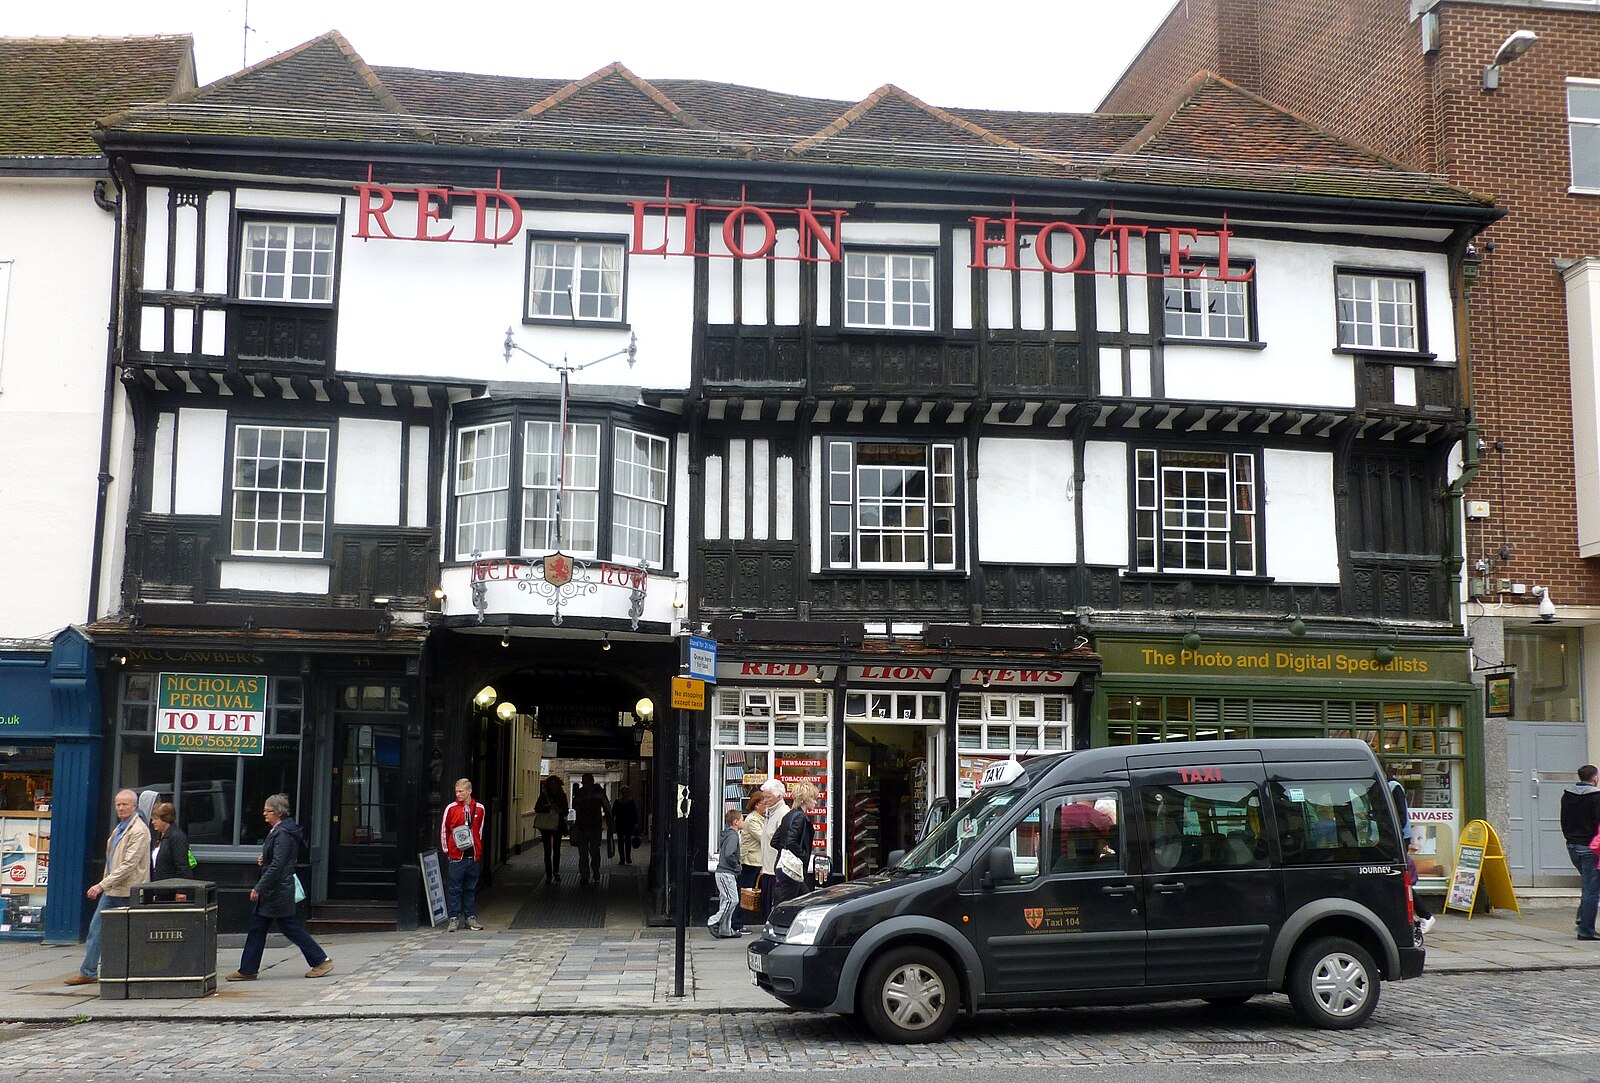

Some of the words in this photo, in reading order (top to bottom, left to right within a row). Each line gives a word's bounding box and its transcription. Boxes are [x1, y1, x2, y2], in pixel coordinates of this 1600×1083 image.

[352, 185, 523, 245] RED
[628, 200, 849, 263] LION
[968, 216, 1255, 282] HOTEL
[1142, 649, 1176, 665] The
[1180, 650, 1233, 666] Photo
[1237, 652, 1270, 668] and
[1276, 653, 1331, 673] Digital
[740, 661, 809, 677] RED
[860, 665, 937, 680] LION
[971, 668, 1063, 682] NEWS
[167, 676, 258, 694] NICHOLAS
[169, 693, 254, 709] PERCIVAL
[682, 690, 703, 699] stopping
[164, 712, 199, 730] TO
[207, 713, 256, 732] LET
[161, 734, 204, 746] 01206
[207, 735, 258, 748] 563222
[984, 766, 1005, 782] TAXI
[1178, 767, 1222, 783] TAXI
[1408, 811, 1454, 821] NVASES
[11, 868, 26, 876] £22
[1359, 866, 1391, 875] JOURNEY
[1045, 918, 1063, 927] Taxi
[1065, 917, 1080, 926] 104
[150, 931, 184, 939] LITTER
